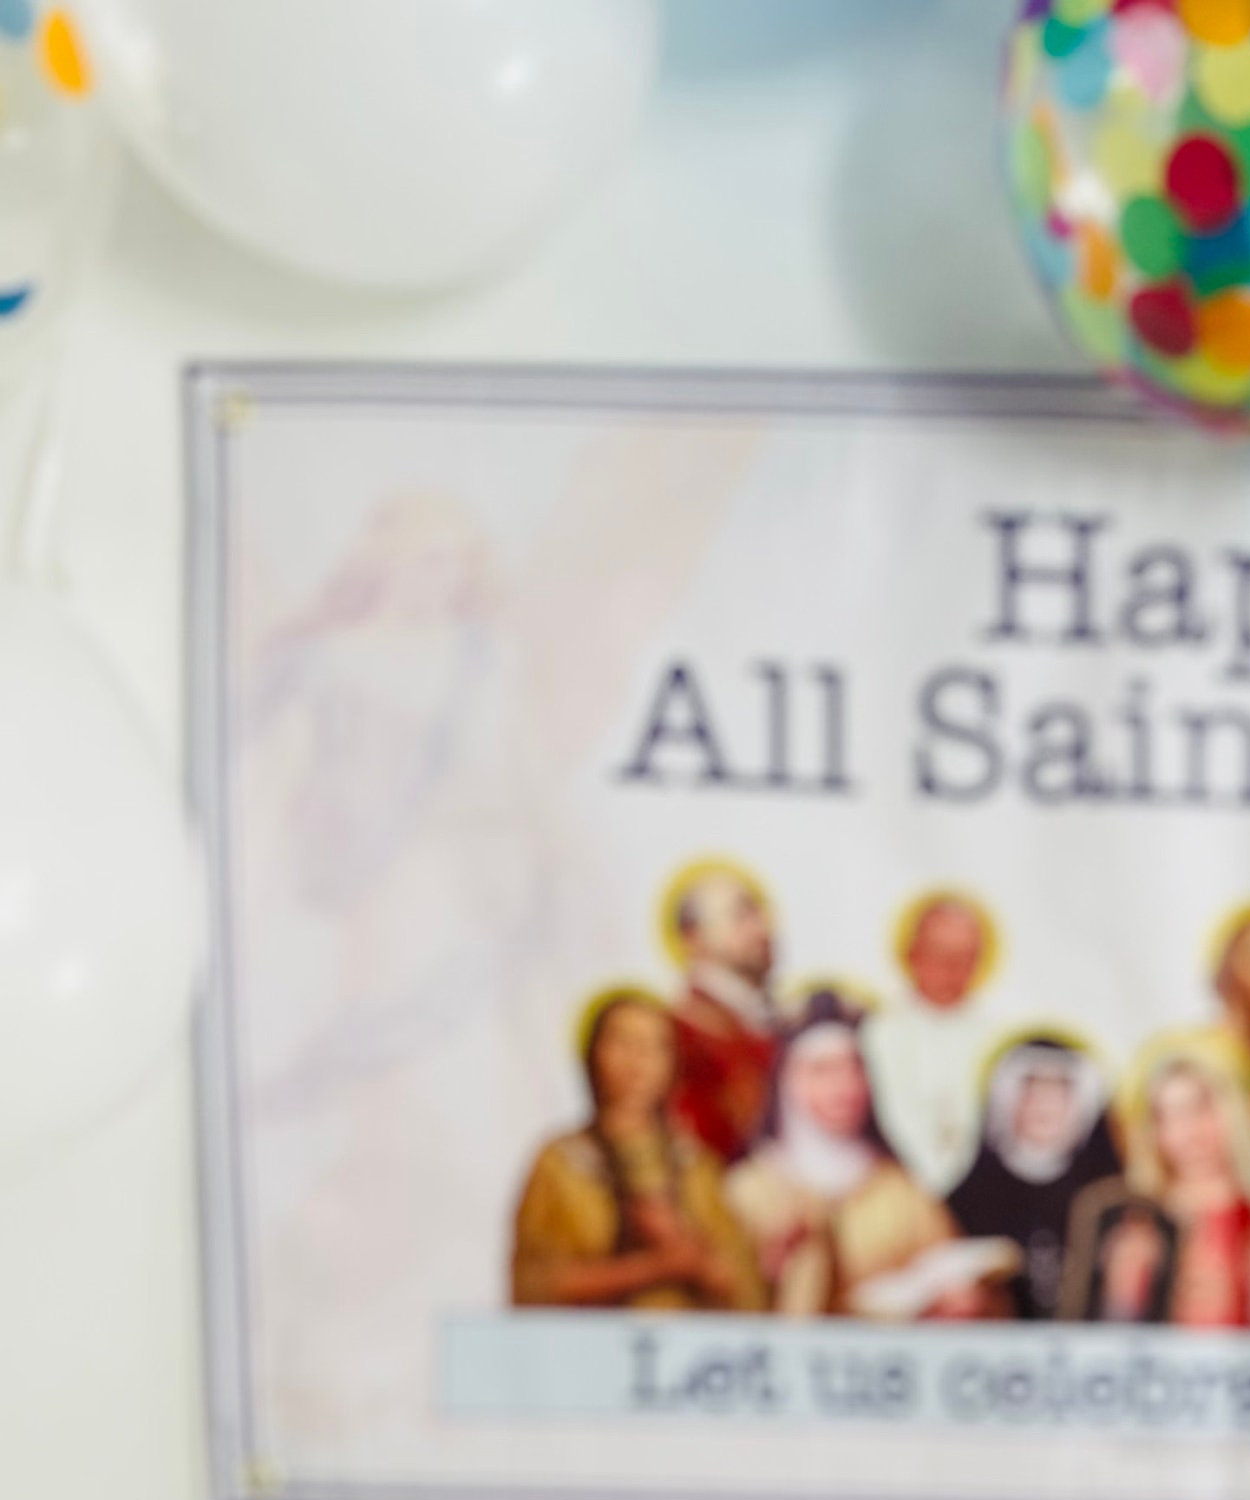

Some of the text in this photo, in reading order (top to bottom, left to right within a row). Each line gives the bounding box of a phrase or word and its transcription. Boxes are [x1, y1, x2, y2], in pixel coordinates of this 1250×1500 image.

[616, 656, 862, 798] All
[629, 1333, 780, 1413] Let
[808, 1346, 917, 1413] us
